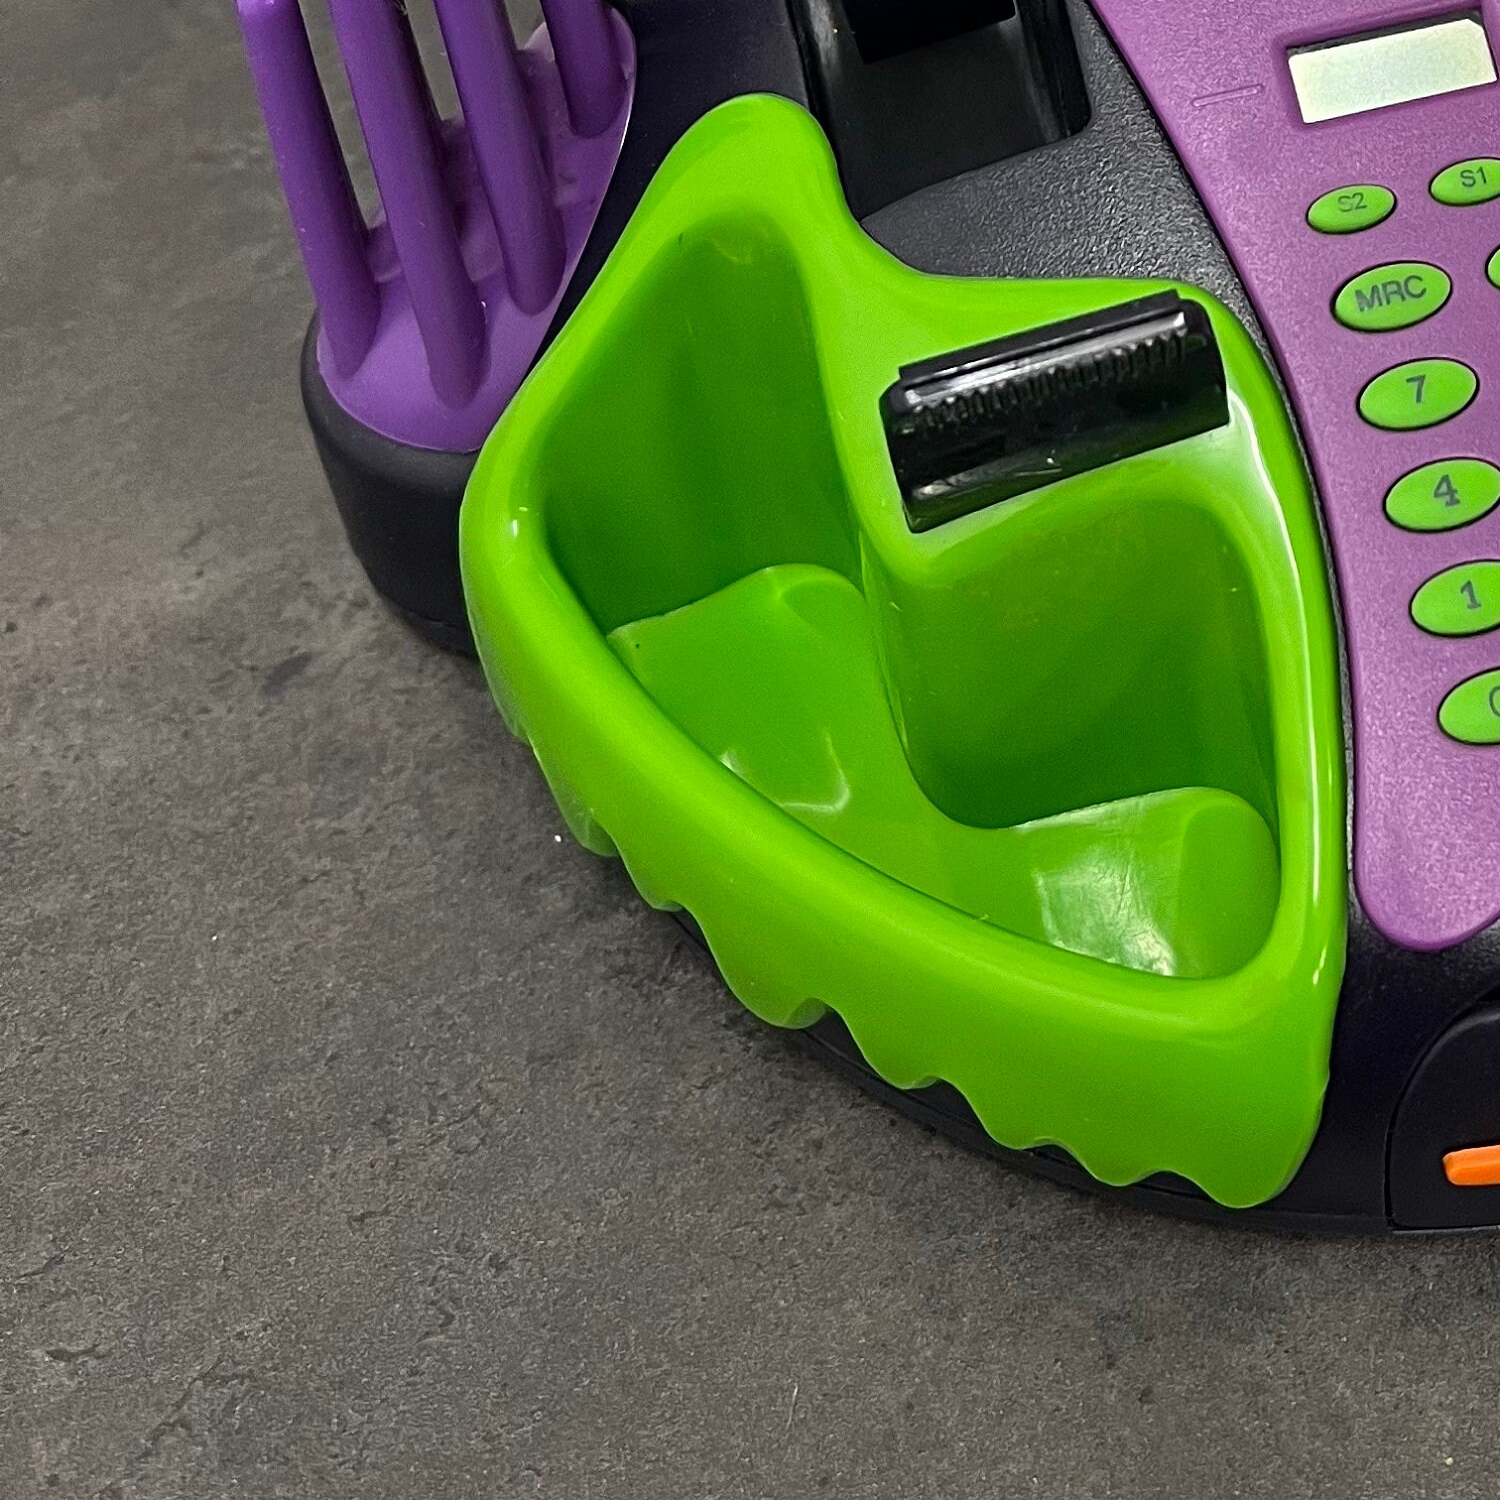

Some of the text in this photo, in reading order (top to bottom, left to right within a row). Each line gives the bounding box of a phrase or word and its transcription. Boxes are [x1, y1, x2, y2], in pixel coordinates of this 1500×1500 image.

[1459, 166, 1488, 188] S1
[1337, 192, 1368, 213] S2
[1354, 274, 1427, 312] MRC
[1405, 373, 1427, 405] 7
[1433, 473, 1462, 508] 4
[1459, 579, 1483, 611] 1
